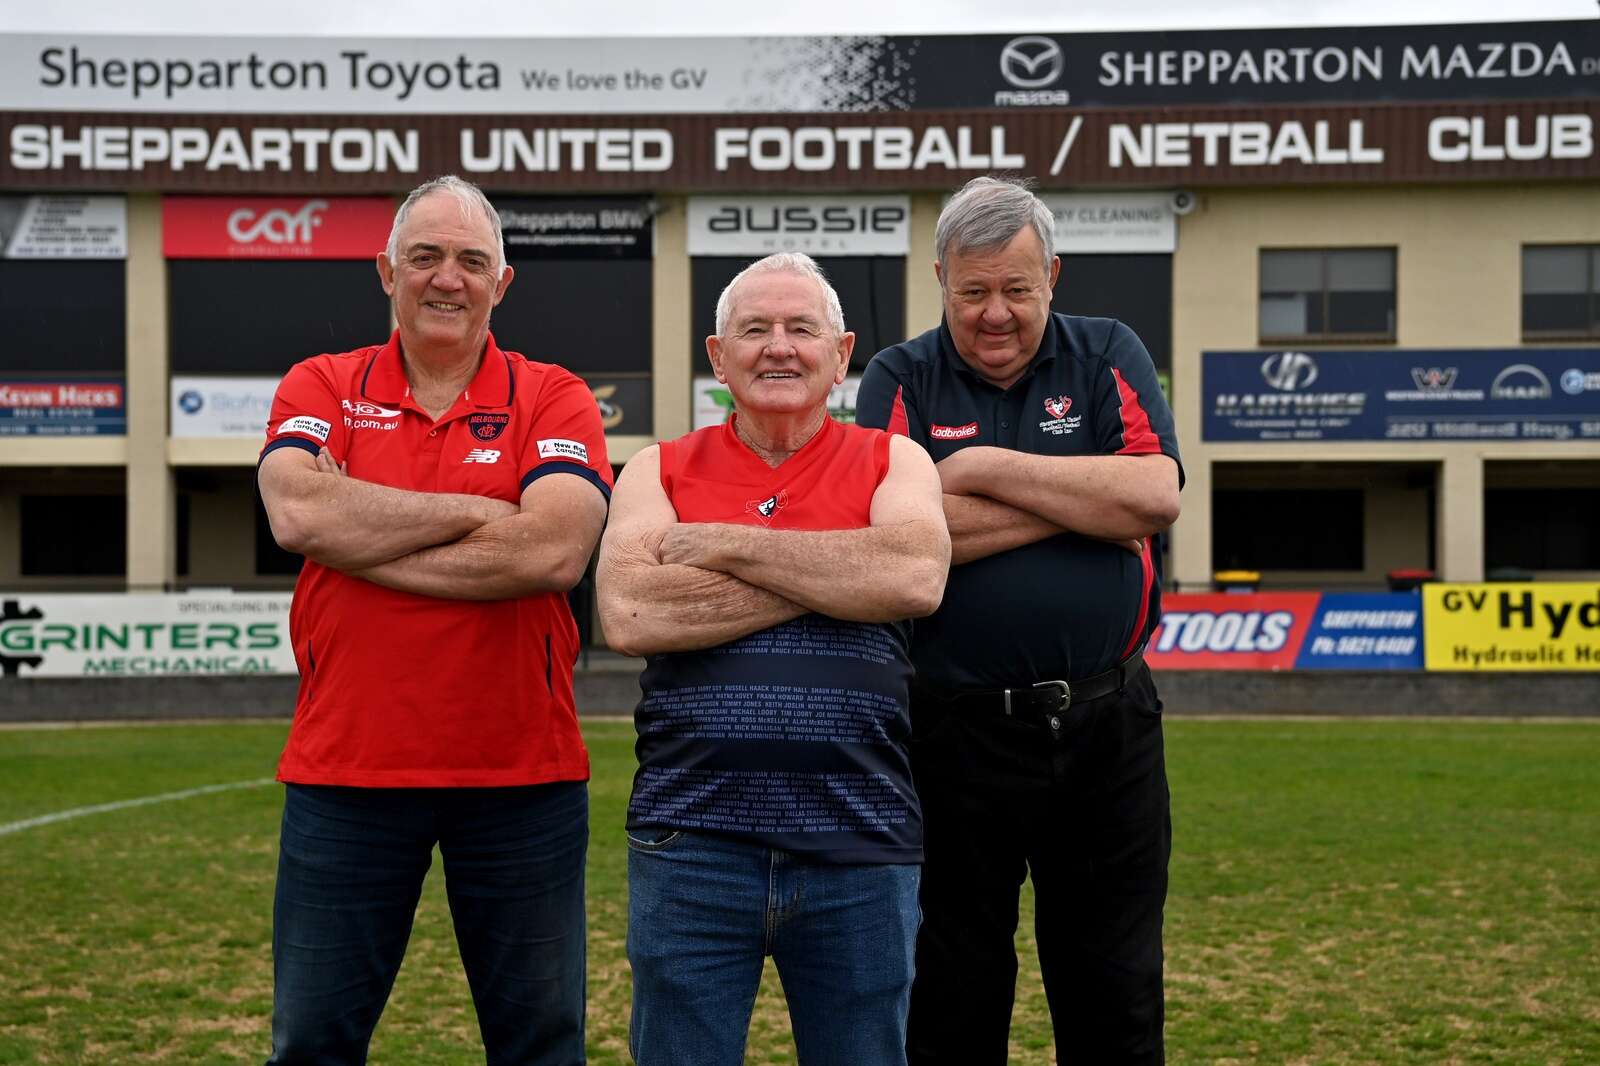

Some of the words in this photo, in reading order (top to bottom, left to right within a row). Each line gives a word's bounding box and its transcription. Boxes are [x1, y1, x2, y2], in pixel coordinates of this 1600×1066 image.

[39, 46, 327, 98] Shepparton
[341, 52, 500, 100] Toyota
[1099, 47, 1382, 85] SHEPPARTON
[1401, 42, 1576, 80] MAZDA
[521, 70, 560, 91] We
[567, 68, 617, 90] love
[625, 69, 663, 90] the
[670, 69, 707, 91] GV
[994, 90, 1069, 106] mazda
[10, 125, 419, 171] SHEPPARTON
[459, 128, 673, 171] UNITED
[714, 126, 1025, 170] FOOTBALL
[1109, 120, 1384, 167] NETBALL
[1428, 114, 1593, 162] CLUB
[500, 210, 596, 233] Shepparton
[708, 207, 904, 233] aussie
[1077, 209, 1164, 222] CLEANING
[471, 415, 508, 423] MELBOURNE
[931, 424, 977, 438] Ladbrokes
[1443, 591, 1486, 612] GV
[1321, 610, 1417, 629] SHEPPARTON
[1, 624, 280, 650] GRINTERS
[1157, 612, 1293, 652] TOOLS
[83, 656, 277, 673] MECHANICAL
[1453, 645, 1565, 669] Hydraulic
[755, 825, 776, 833] BRUCE
